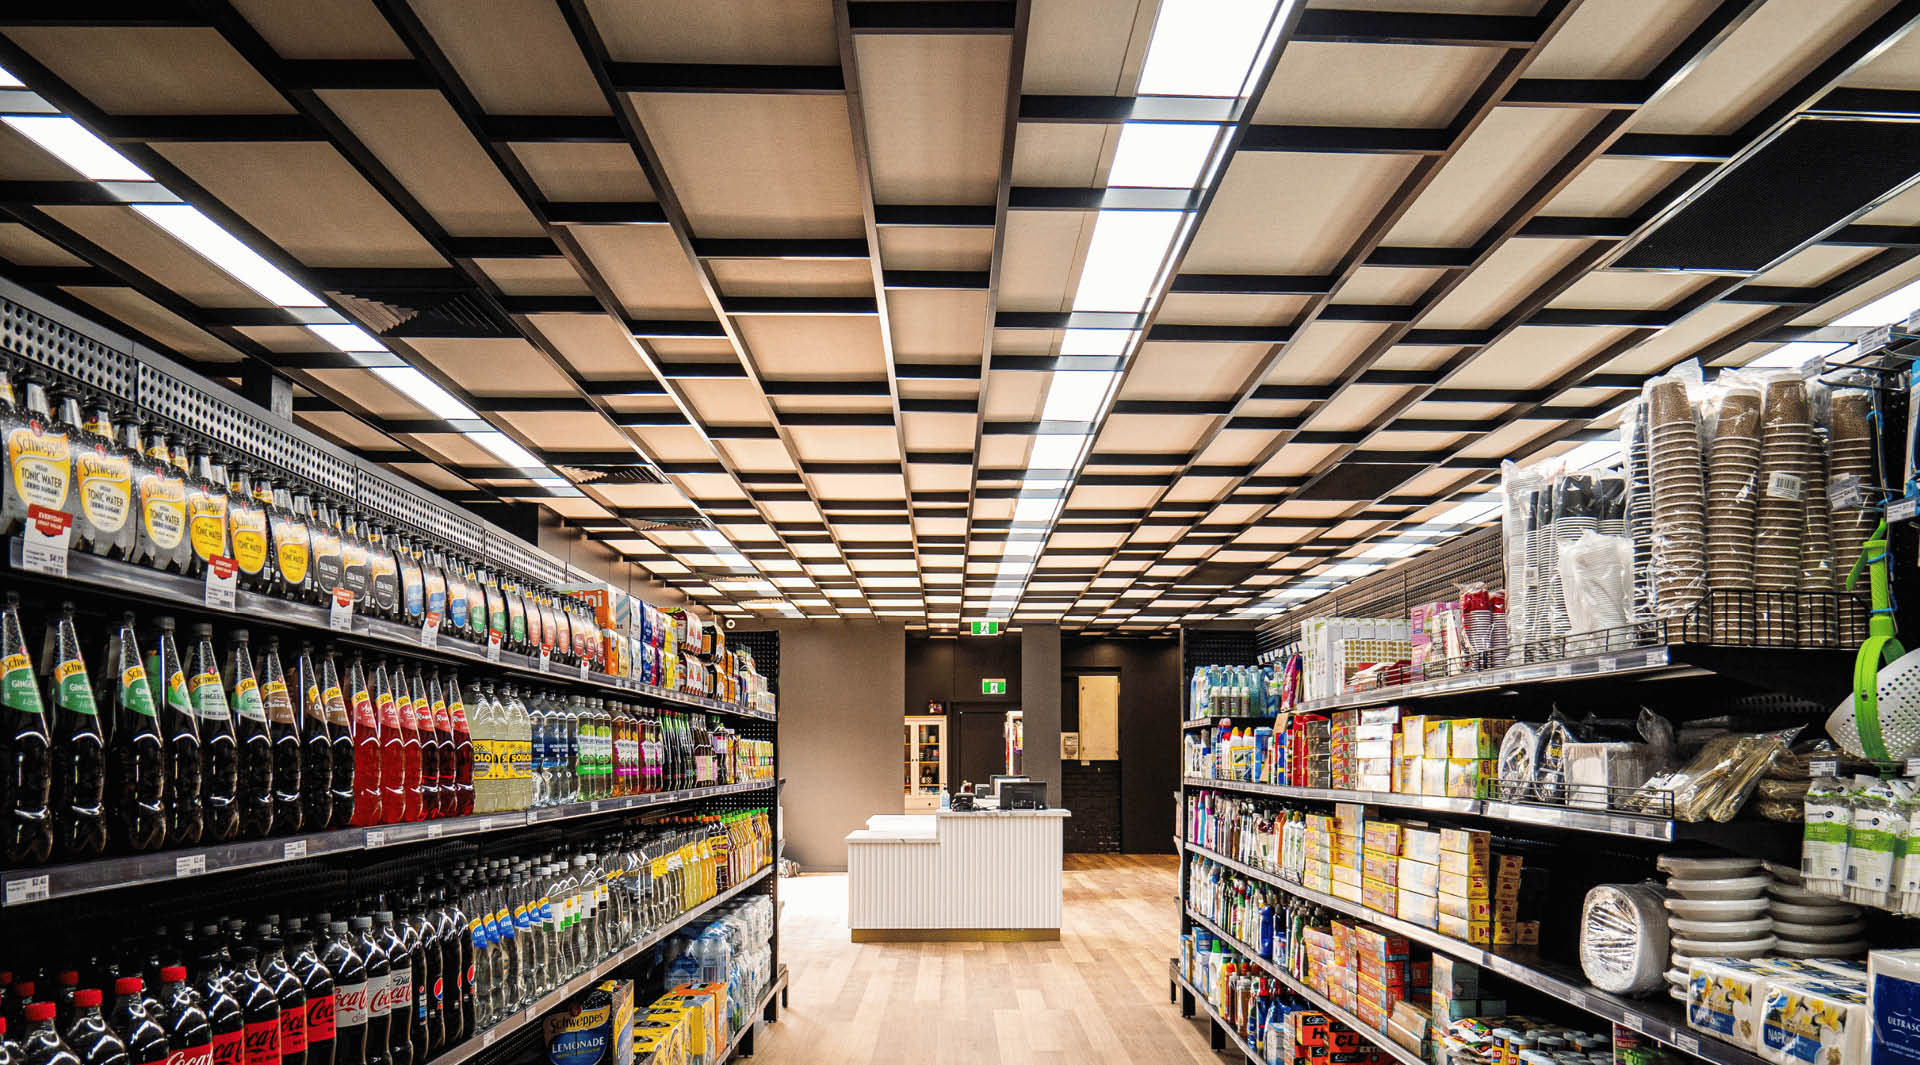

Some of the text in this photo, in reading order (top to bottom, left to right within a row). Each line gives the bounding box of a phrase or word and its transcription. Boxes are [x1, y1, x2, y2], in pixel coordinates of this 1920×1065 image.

[21, 467, 62, 488] TONIC WATER
[88, 488, 124, 507] TONIC WATER
[150, 508, 180, 526] TONIC WATER
[195, 526, 222, 541] TONIC WATER
[550, 1011, 604, 1031] Schweppes
[552, 1036, 605, 1054] LEMONADE
